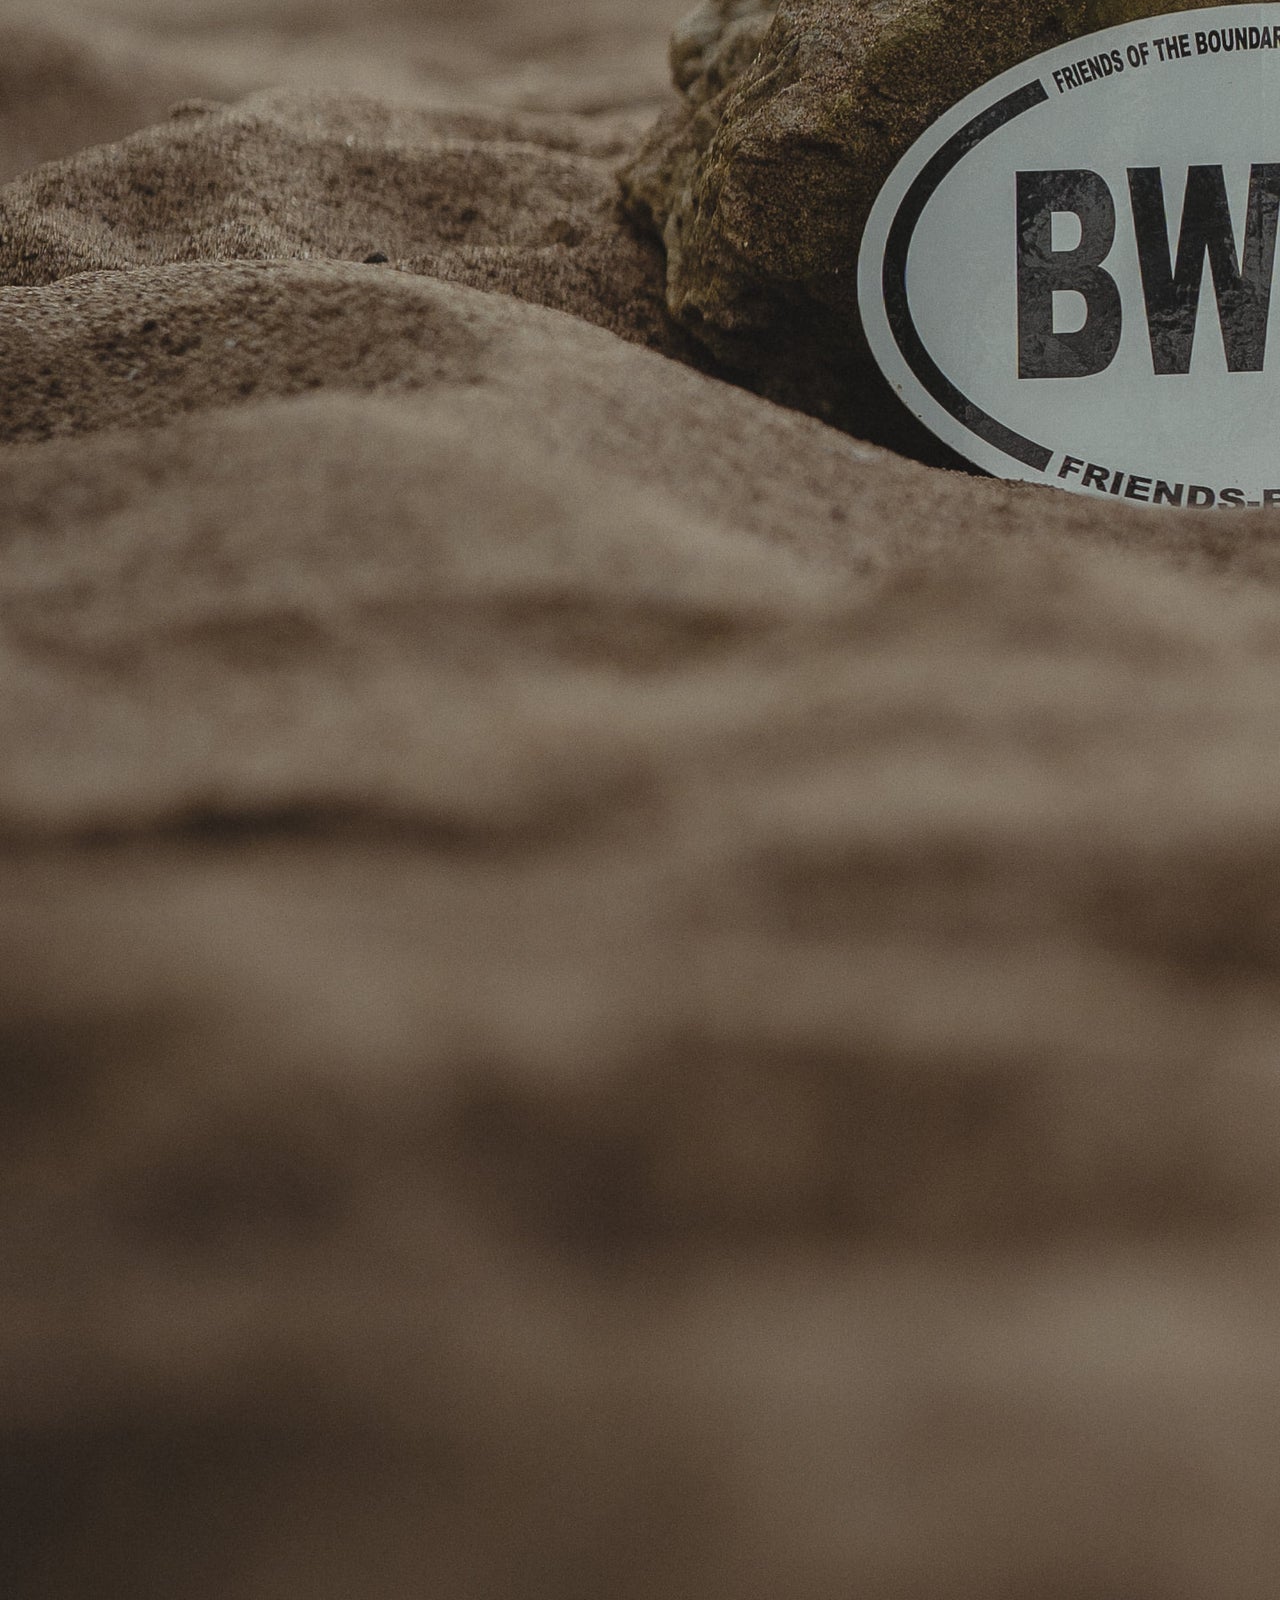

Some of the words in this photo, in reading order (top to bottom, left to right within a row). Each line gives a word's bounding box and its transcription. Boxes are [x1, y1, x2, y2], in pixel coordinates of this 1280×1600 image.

[1051, 49, 1125, 94] FRIENDS
[1126, 41, 1150, 68] OF
[1152, 33, 1192, 62] THE
